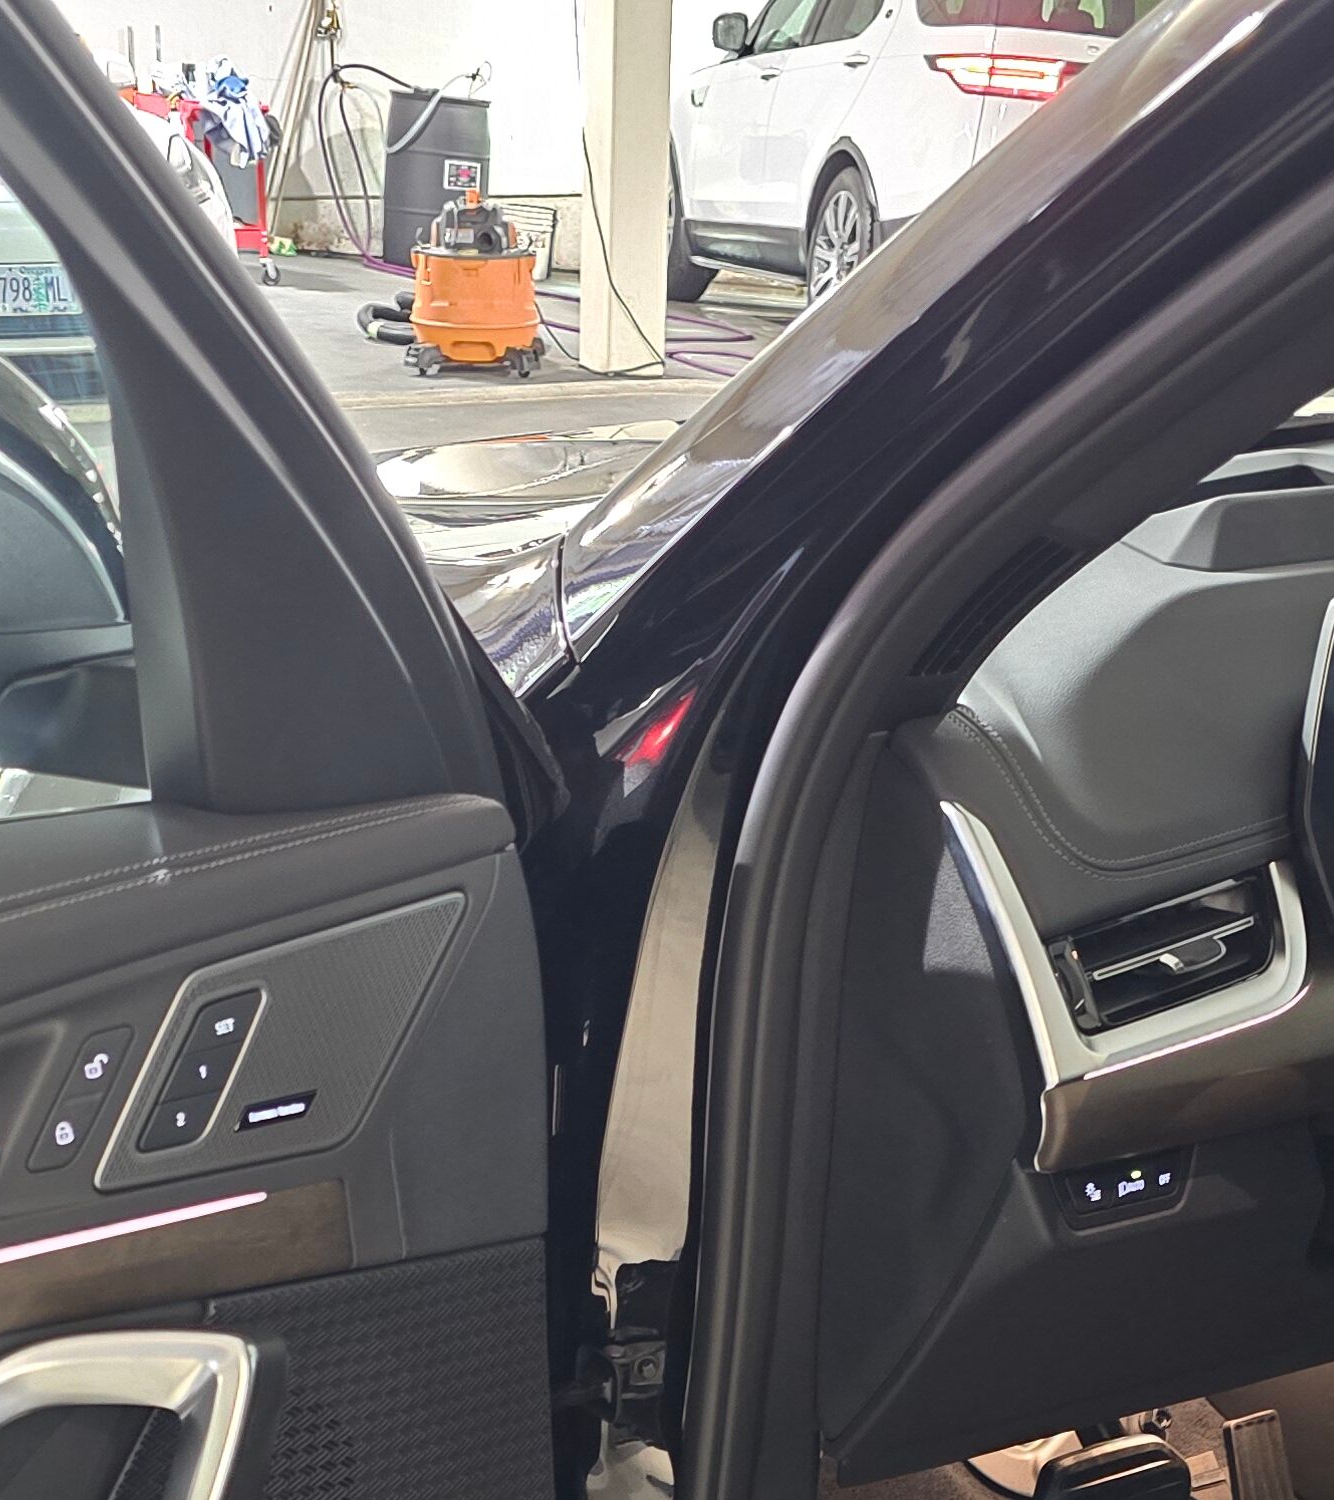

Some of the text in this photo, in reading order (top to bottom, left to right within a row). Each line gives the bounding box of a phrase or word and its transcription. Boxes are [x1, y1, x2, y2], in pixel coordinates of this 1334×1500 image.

[44, 276, 69, 303] ML
[214, 1017, 236, 1036] SET
[198, 1064, 208, 1080] 1
[175, 1111, 187, 1128] 2
